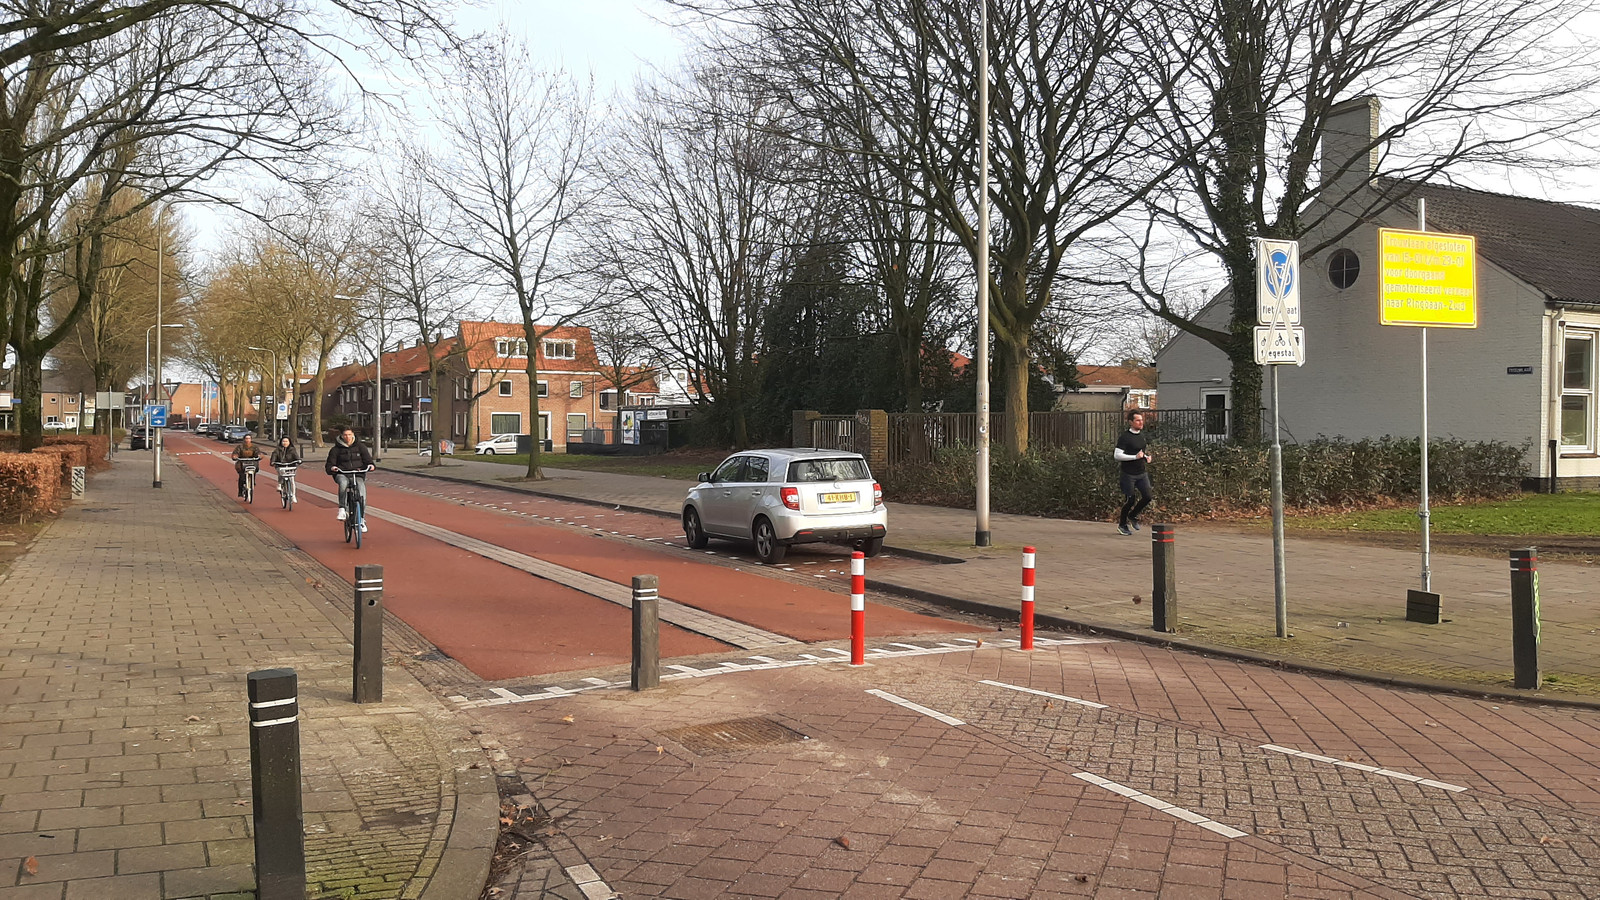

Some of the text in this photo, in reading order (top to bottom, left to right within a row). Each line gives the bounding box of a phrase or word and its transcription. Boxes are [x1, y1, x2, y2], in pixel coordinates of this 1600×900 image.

[1426, 240, 1466, 253] afgesloten
[1385, 253, 1400, 262] van
[1385, 268, 1402, 277] voor
[1385, 283, 1441, 295] gemotoriseerd
[1385, 298, 1404, 308] naar
